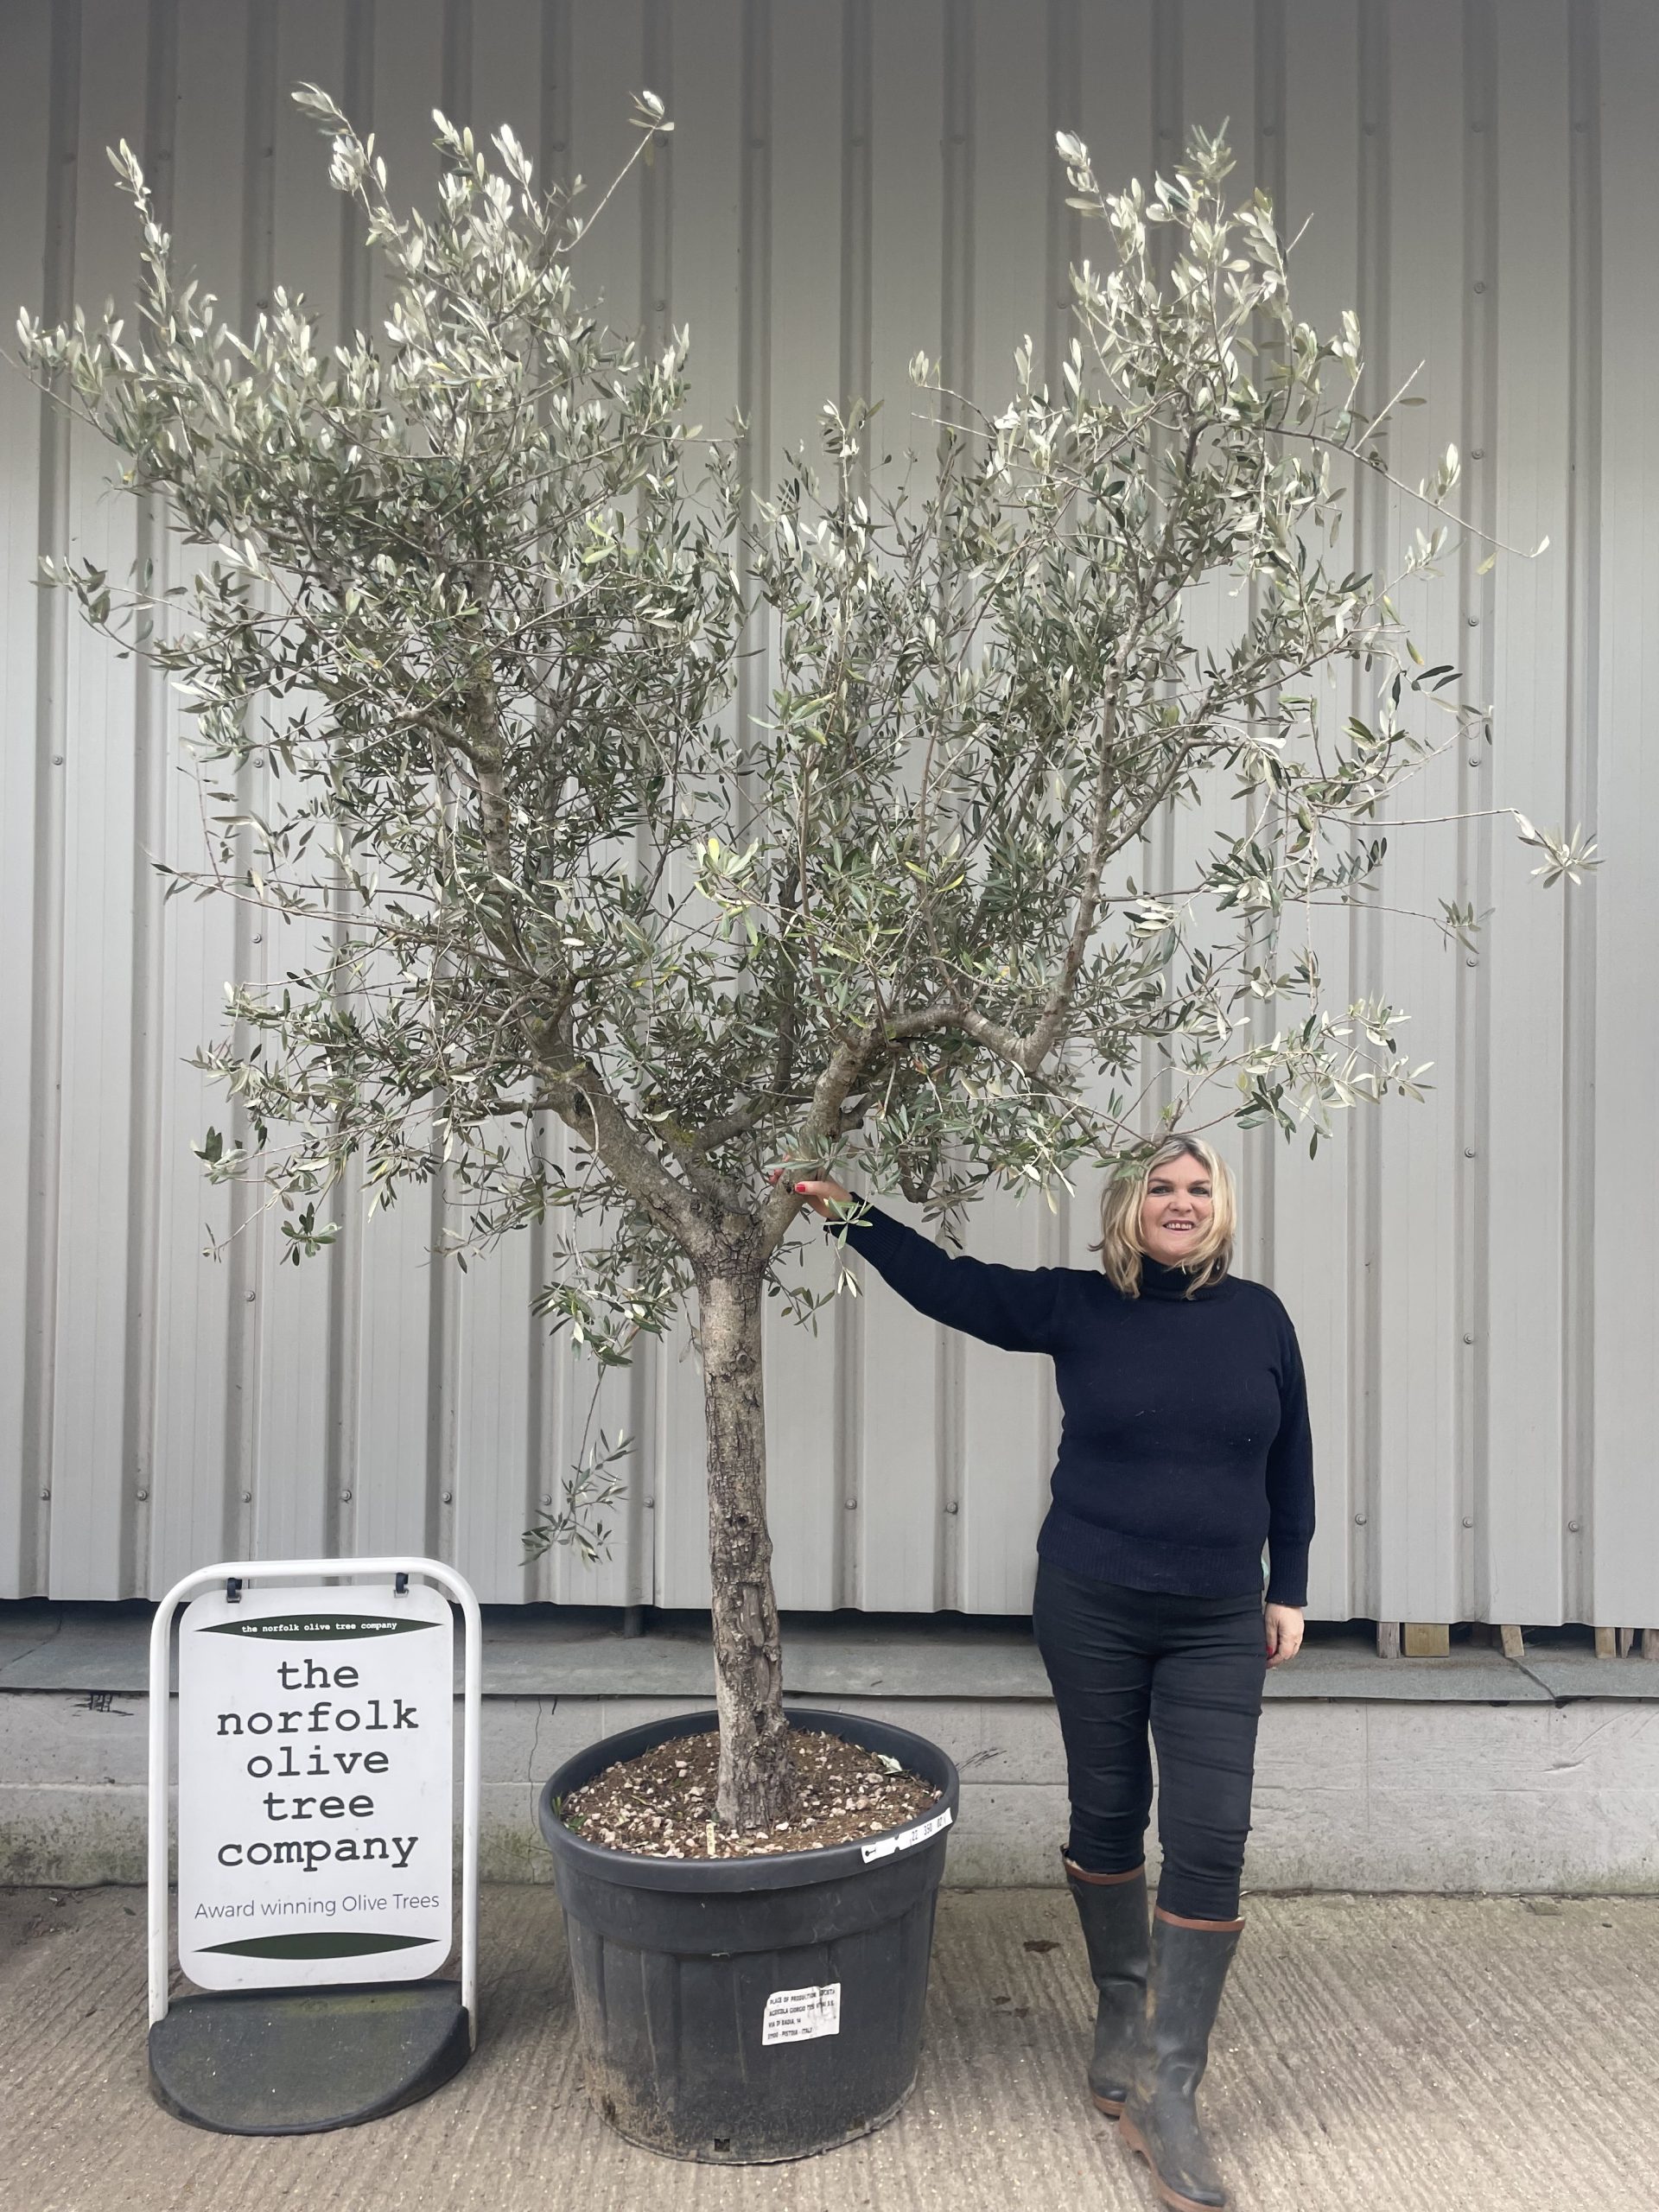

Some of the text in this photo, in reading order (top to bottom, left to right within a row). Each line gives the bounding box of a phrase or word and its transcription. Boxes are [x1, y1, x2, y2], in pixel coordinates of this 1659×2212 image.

[360, 1622, 397, 1630] company
[276, 1658, 359, 1690] the
[216, 1699, 419, 1736] norfolk
[247, 1745, 389, 1778] olive
[263, 1792, 374, 1821] tree
[218, 1835, 419, 1872] company
[194, 1892, 440, 1919] Award winning Olive Trees
